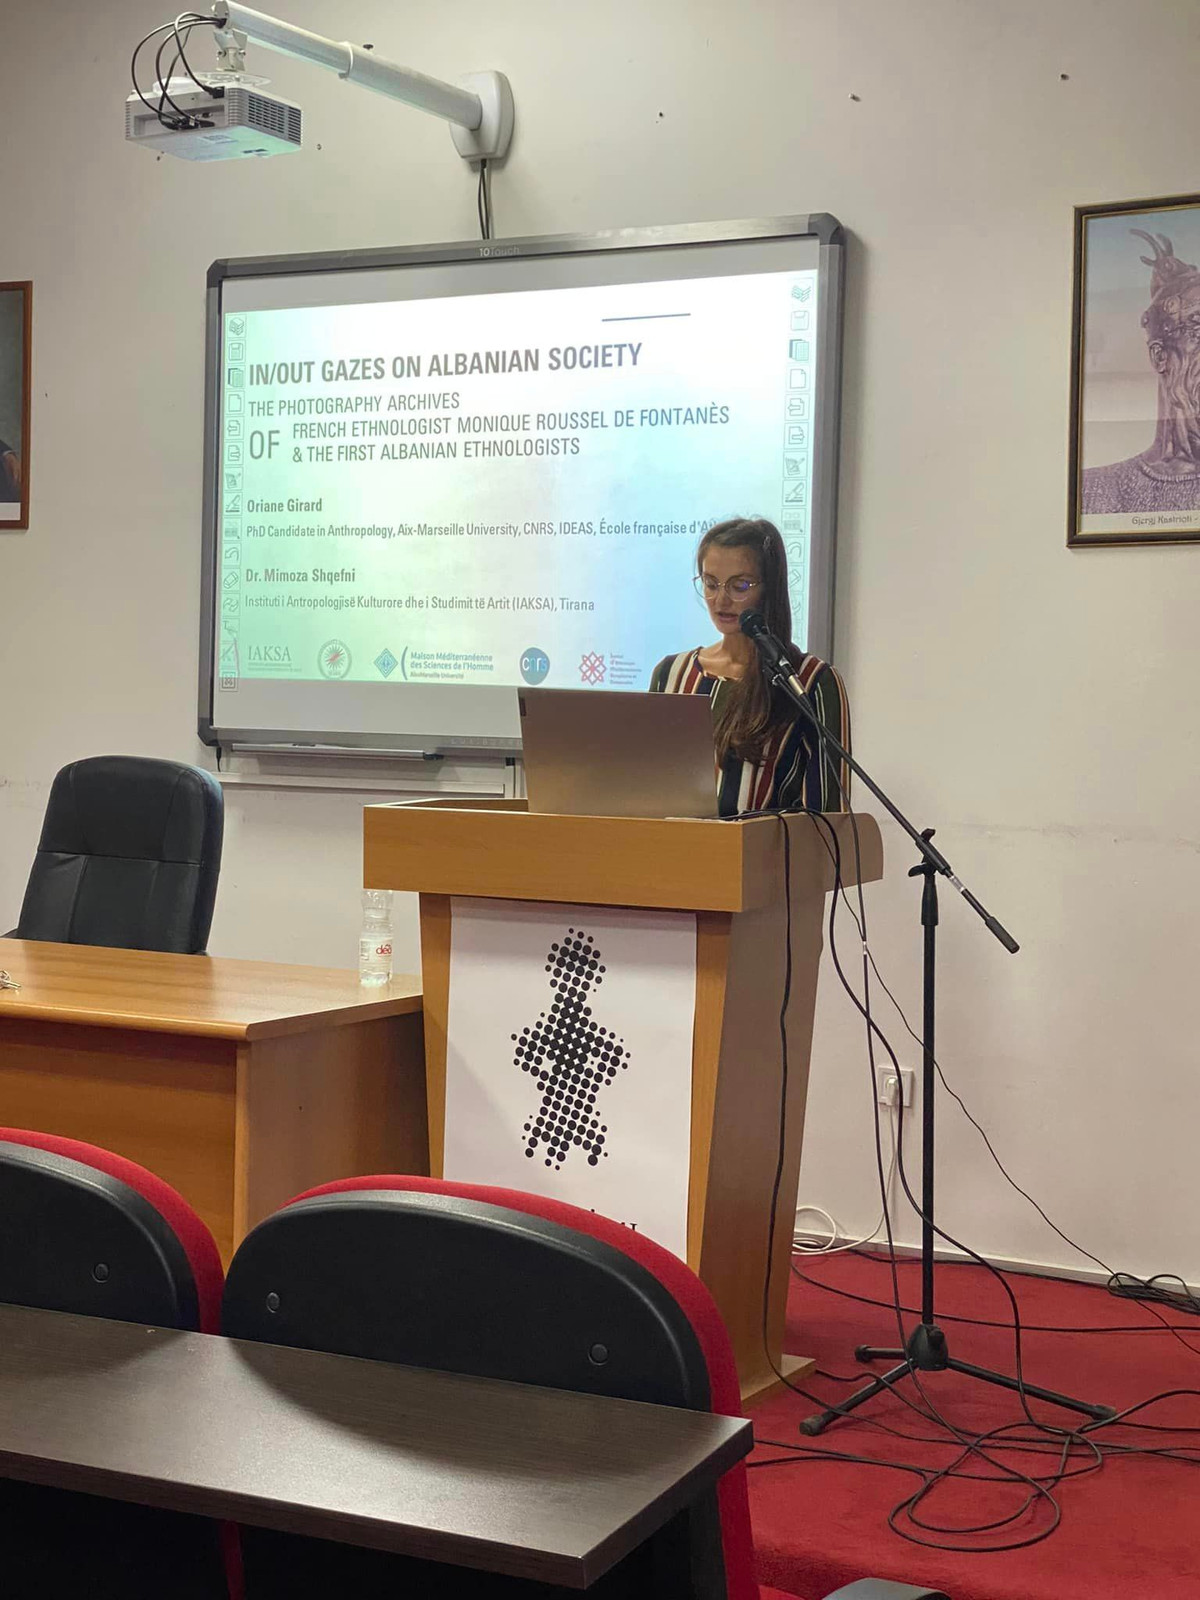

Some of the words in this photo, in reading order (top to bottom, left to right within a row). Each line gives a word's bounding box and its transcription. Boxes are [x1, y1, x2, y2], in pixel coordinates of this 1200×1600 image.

[249, 361, 315, 386] IN/OUT
[322, 358, 385, 382] GAZES
[392, 355, 421, 378] ON
[428, 348, 539, 376] ALBANIAN
[548, 342, 642, 371] SOCIETY
[248, 400, 274, 417] THE
[279, 396, 382, 416] PHOTOGRAPHY
[388, 392, 460, 412] ARCHIVES
[293, 422, 346, 439] FRENCH
[352, 418, 451, 437] ETHNOLOGIST
[458, 414, 530, 434] MONIQUE
[536, 412, 608, 430] ROUSSEL
[614, 410, 634, 427] DE
[640, 402, 729, 426] FONTANÈS
[249, 430, 280, 460] OF
[292, 447, 303, 463] &
[307, 446, 333, 462] THE
[338, 444, 375, 461] FIRST
[380, 442, 457, 460] ALBANIAN
[464, 438, 580, 458] ETHNOLOGISTS
[247, 499, 284, 513] Oriane
[287, 498, 322, 512] Girard
[246, 526, 266, 538] PhD
[268, 524, 316, 537] Candidate
[316, 525, 326, 536] in
[327, 524, 396, 539] Anthropology,
[398, 522, 464, 536] Aix-Marseille
[466, 522, 522, 537] University,
[524, 522, 556, 536] CNRS,
[559, 522, 596, 536] IDEAS,
[600, 518, 631, 534] École
[632, 520, 687, 538] française
[246, 569, 262, 582] Dr.
[264, 568, 308, 582] Mimoza
[312, 568, 356, 585] Shqefni
[357, 596, 403, 608] Kulturore
[405, 596, 424, 608] dhe
[431, 596, 474, 610] Studimit
[487, 598, 510, 610] Artit
[512, 597, 558, 612] (IAKSA),
[559, 598, 595, 611] Tirana
[248, 646, 291, 662] IAKSA
[411, 652, 434, 660] Maison
[424, 661, 452, 670] Sciences
